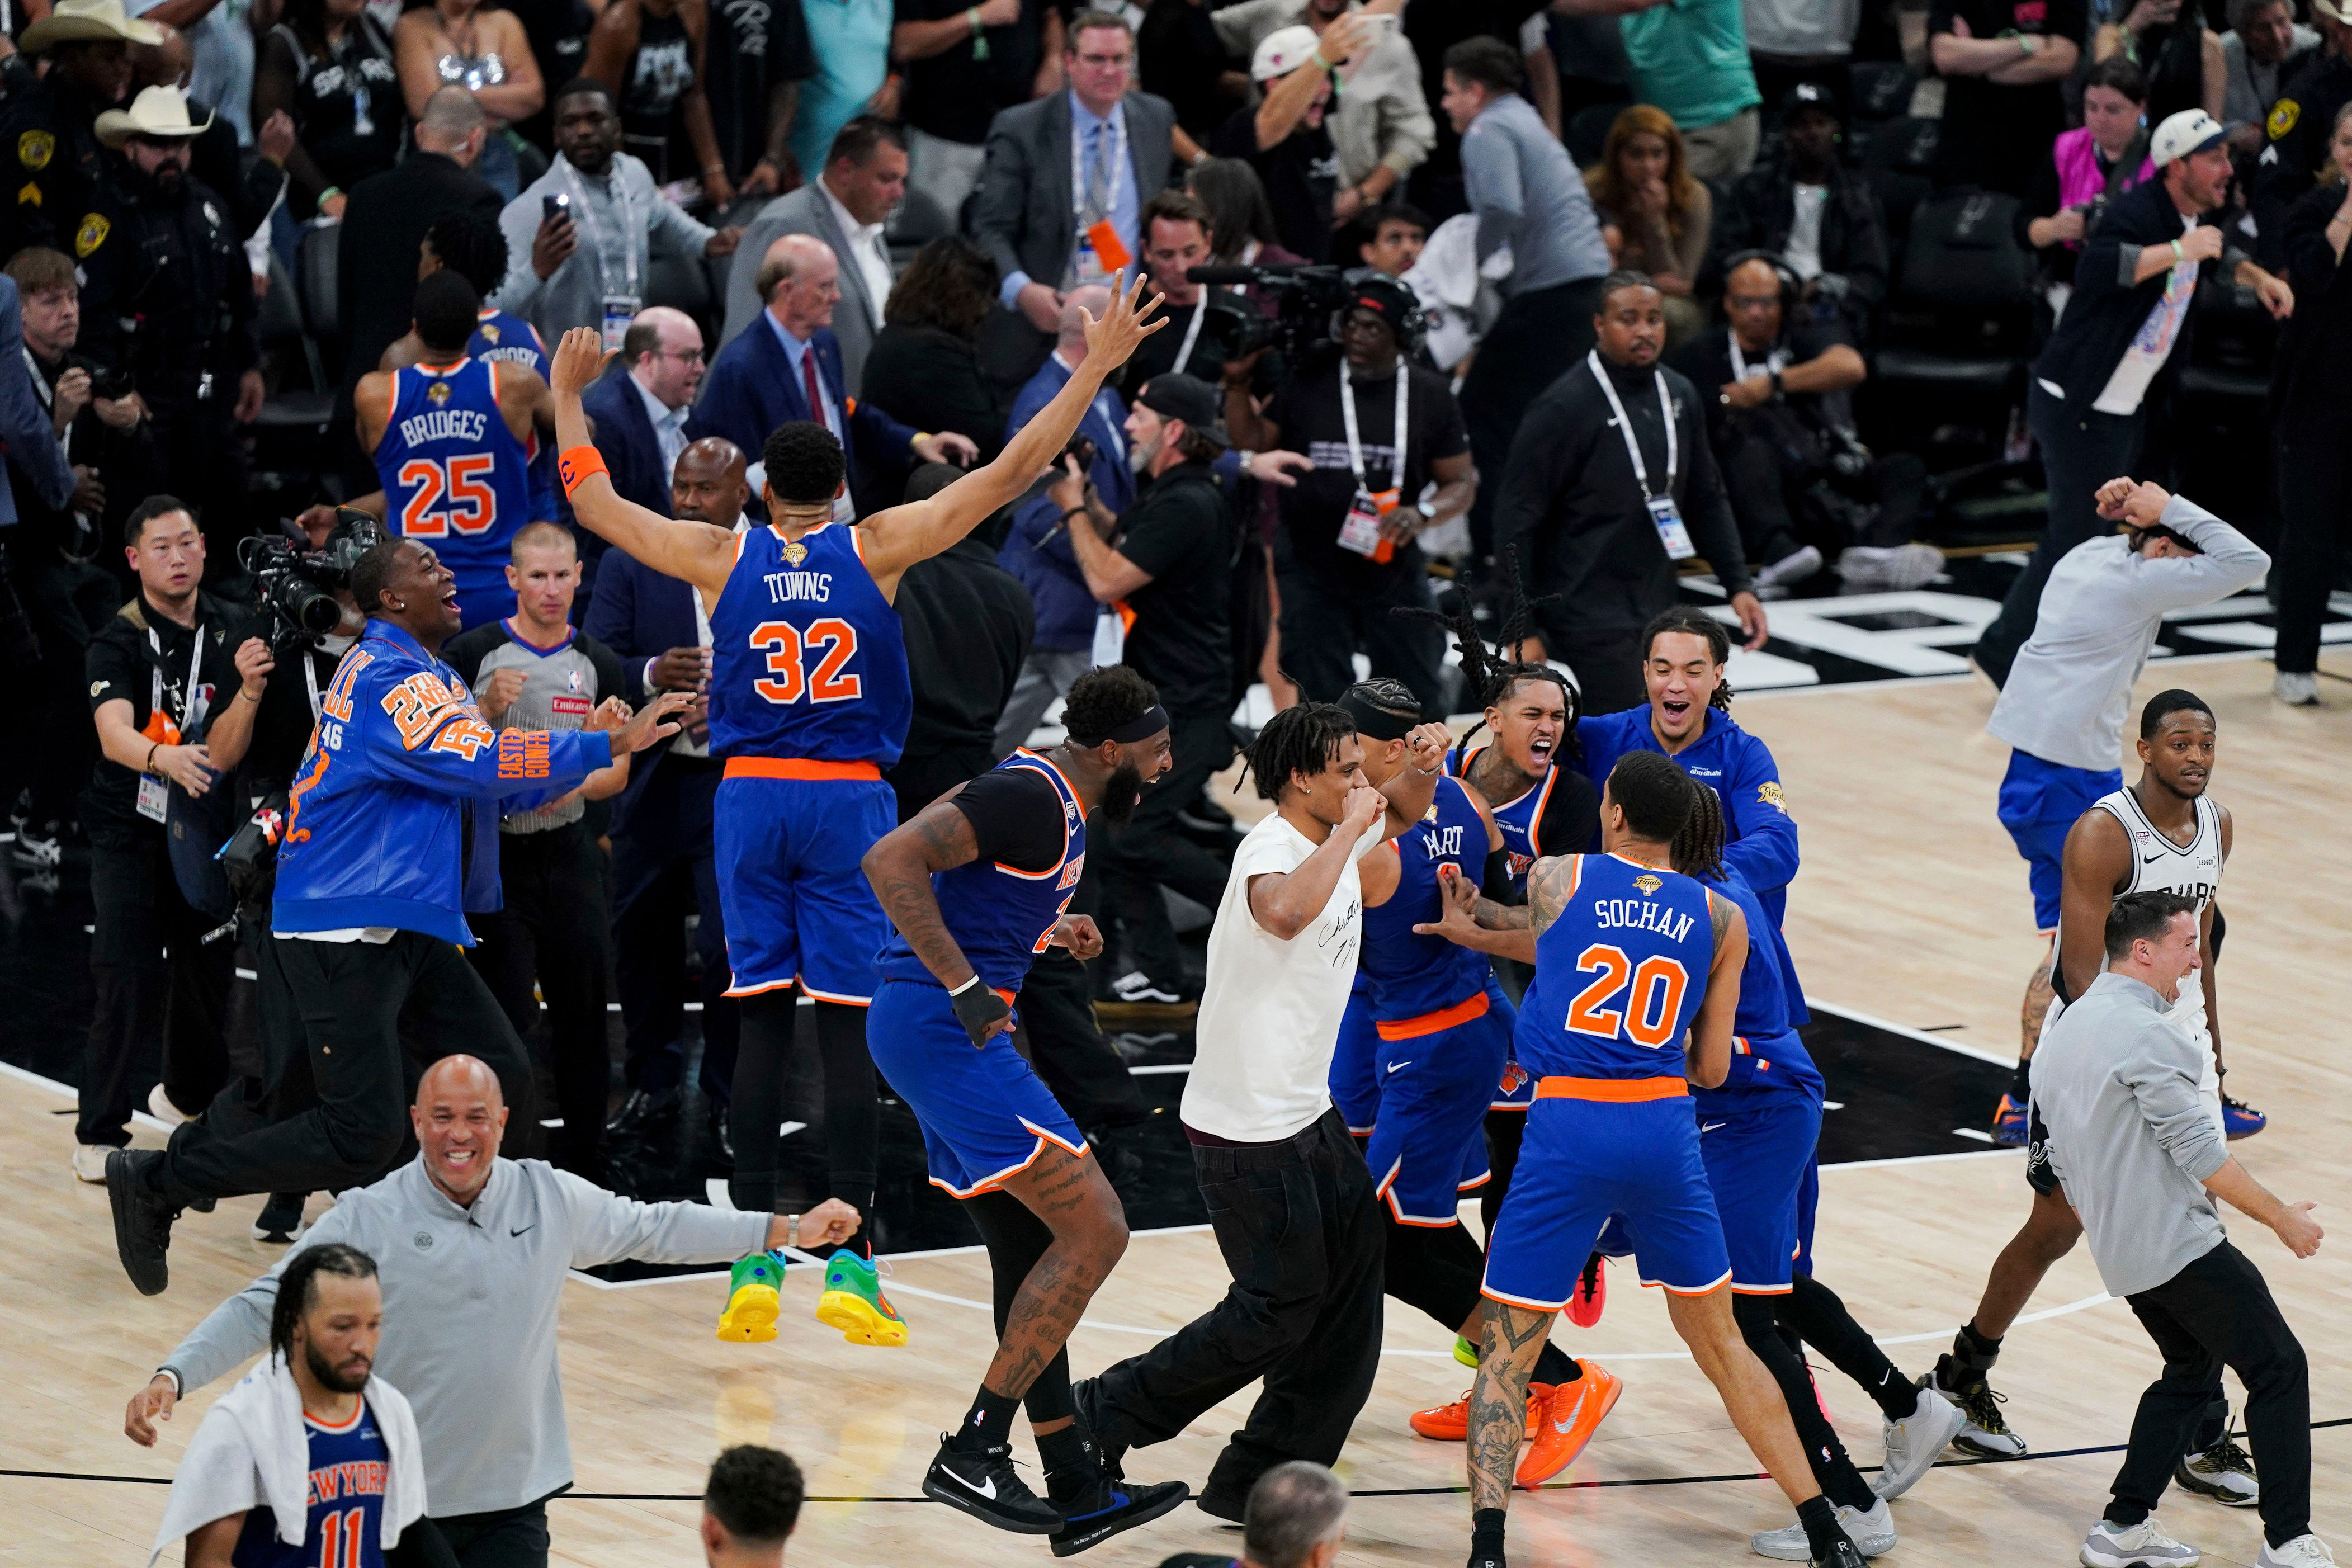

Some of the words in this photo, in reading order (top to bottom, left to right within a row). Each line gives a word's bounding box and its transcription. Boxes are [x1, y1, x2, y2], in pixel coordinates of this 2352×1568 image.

[400, 410, 487, 448] BRIDGES
[398, 452, 497, 538] 25
[783, 546, 806, 558] Finals
[763, 571, 832, 603] TOWNS
[749, 617, 862, 704] 32
[380, 684, 430, 737] 2
[553, 699, 589, 711] Emirates
[322, 721, 343, 750] 46
[498, 727, 525, 778] EASTE
[1505, 824, 1525, 834] dhabi
[1636, 876, 1662, 888] Finals
[1595, 899, 1695, 943] SOCHAN
[1564, 943, 1689, 1049] 20
[320, 1506, 365, 1568] 11
